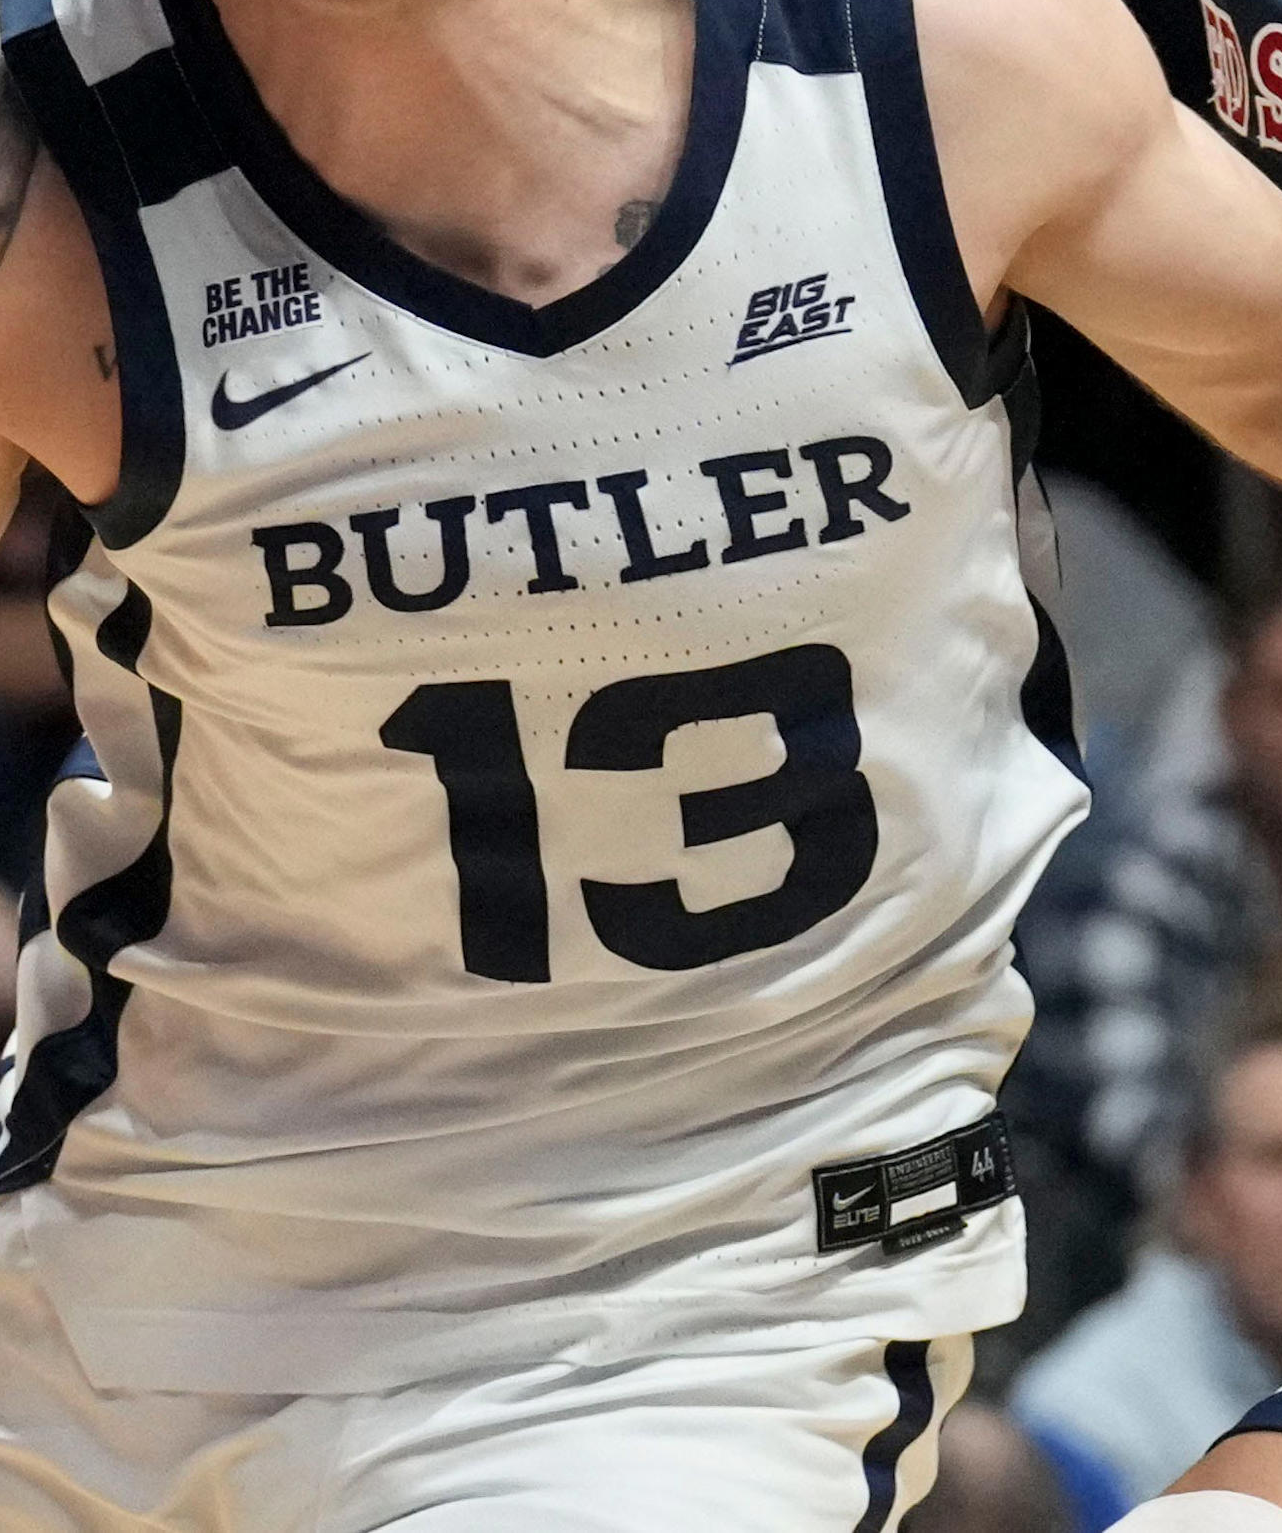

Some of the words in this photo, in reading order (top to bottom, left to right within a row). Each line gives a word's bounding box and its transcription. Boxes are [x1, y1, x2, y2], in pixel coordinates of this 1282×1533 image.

[206, 277, 243, 315] BE
[250, 262, 310, 301] THE
[745, 271, 829, 321] BIG
[202, 291, 322, 349] CHANGE
[736, 295, 856, 350] EAST
[251, 434, 911, 628] BUTLER
[378, 643, 879, 984] 13
[972, 1146, 995, 1183] 44
[833, 1204, 881, 1229] ELITE
